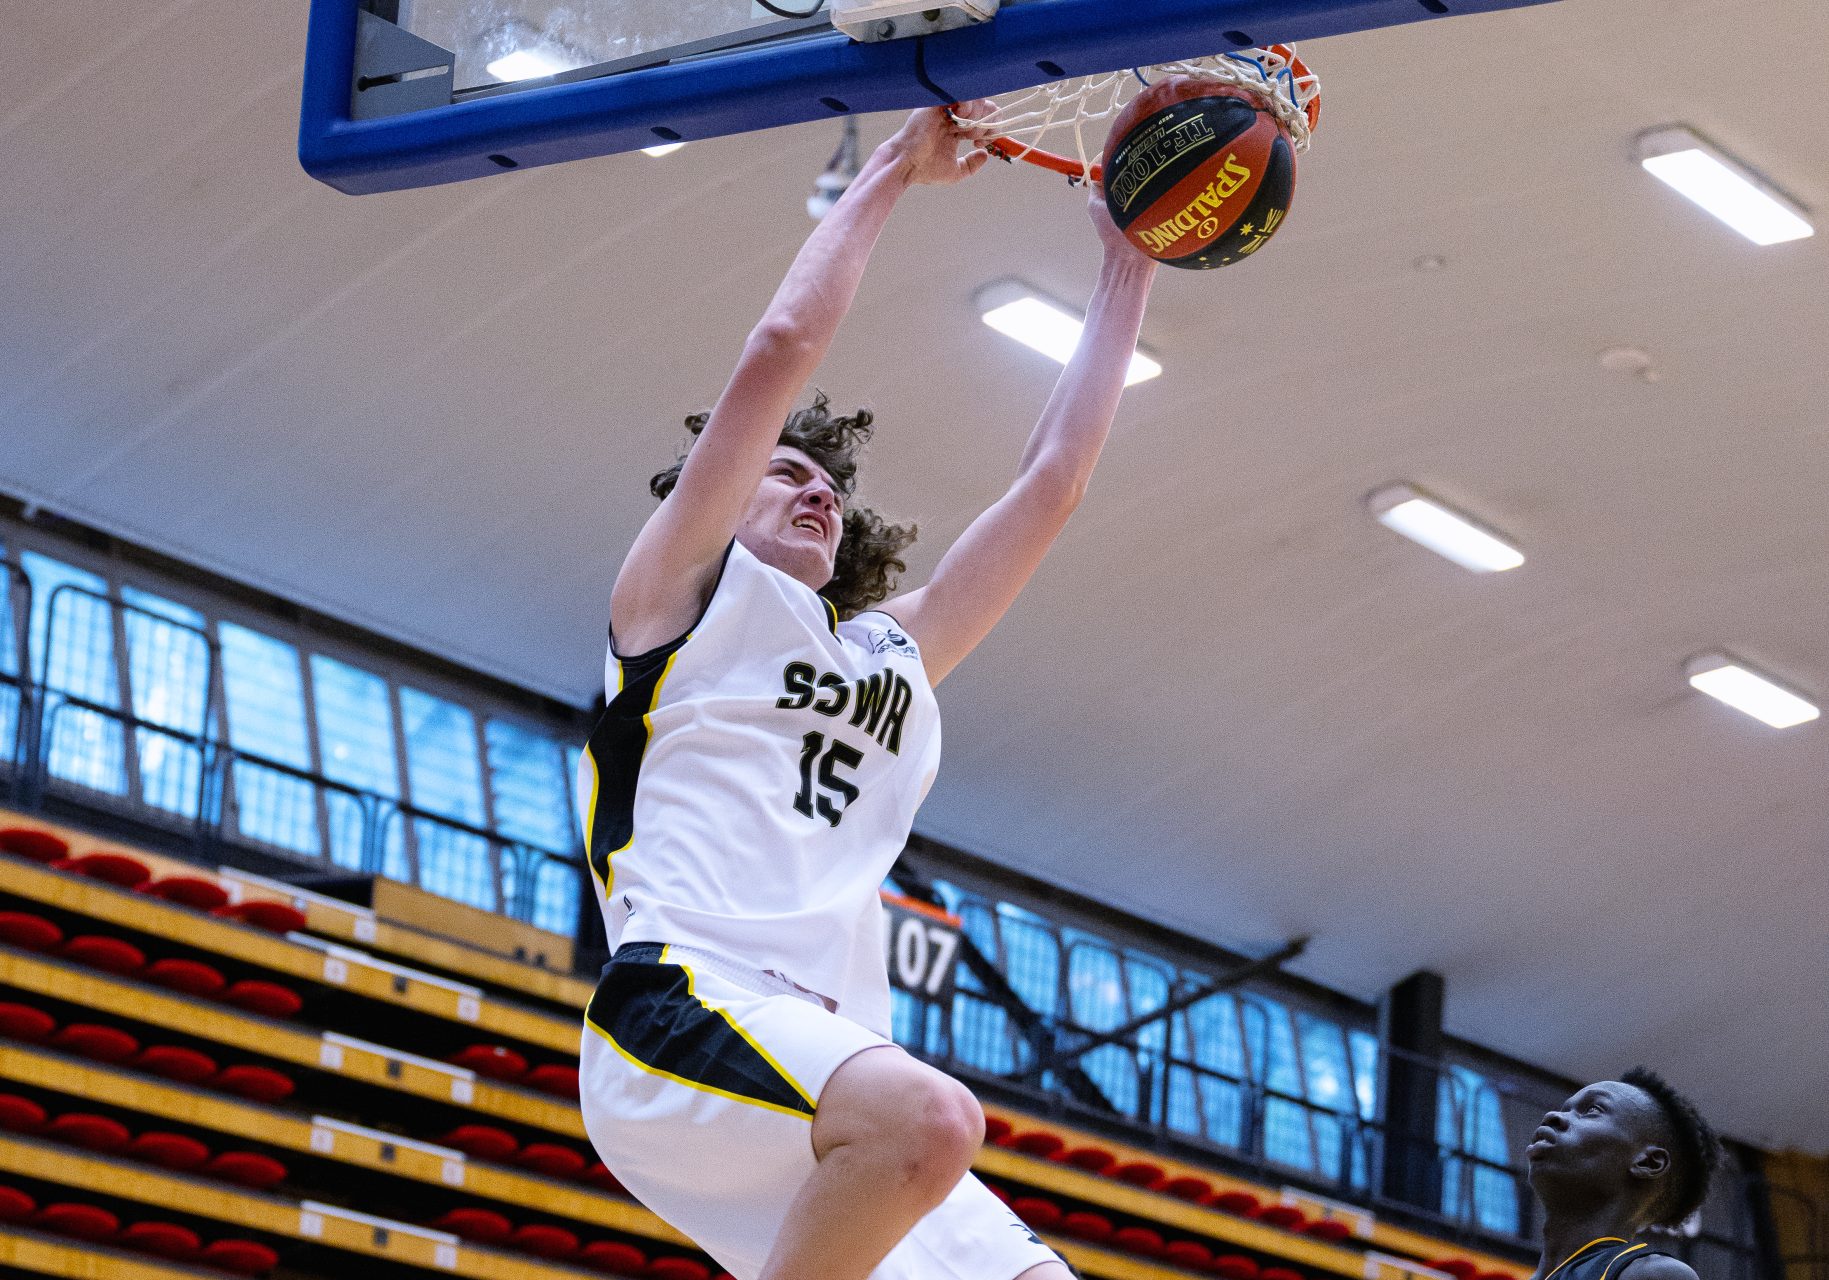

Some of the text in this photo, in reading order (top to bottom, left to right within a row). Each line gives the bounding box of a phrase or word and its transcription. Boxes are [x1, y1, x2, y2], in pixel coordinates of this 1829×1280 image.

[1112, 117, 1215, 207] TF-1000
[1138, 153, 1251, 253] SPALDING
[793, 730, 864, 828] 15
